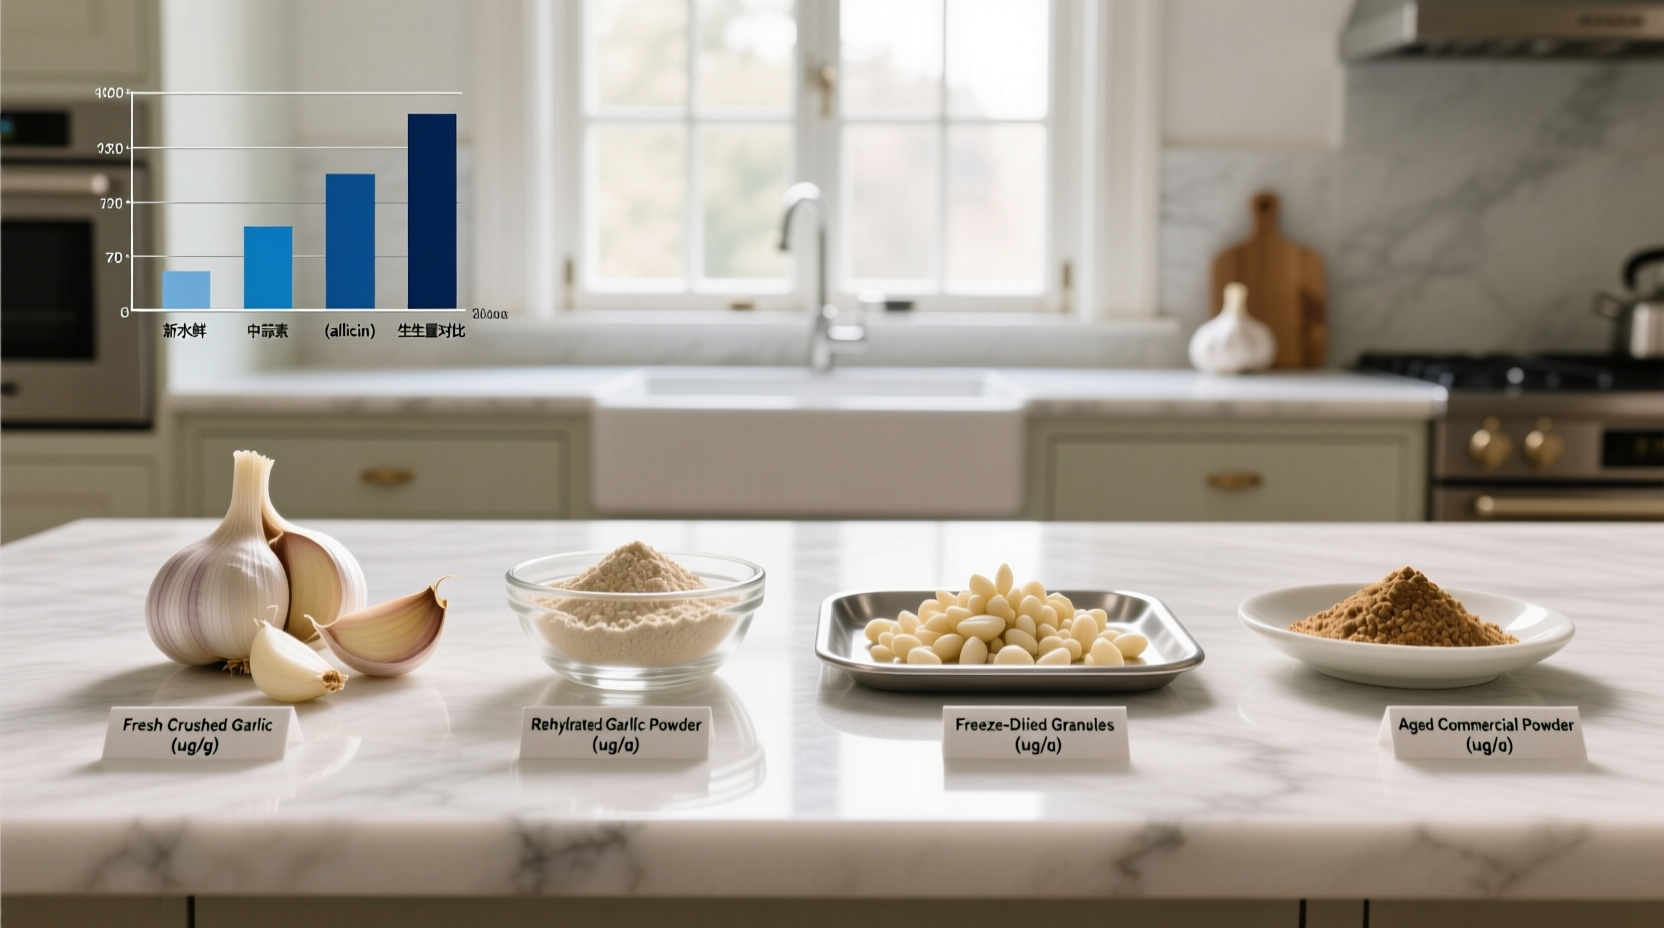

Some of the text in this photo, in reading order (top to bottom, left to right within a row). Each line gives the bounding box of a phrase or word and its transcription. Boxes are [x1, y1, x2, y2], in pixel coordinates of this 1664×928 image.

[122, 717, 273, 732] Fresh Crushed Garlic
[649, 717, 703, 732] Powder
[1051, 717, 1115, 732] Granules
[1398, 717, 1575, 735] Aged Commercial Powder
[171, 736, 219, 756] (ug/g)
